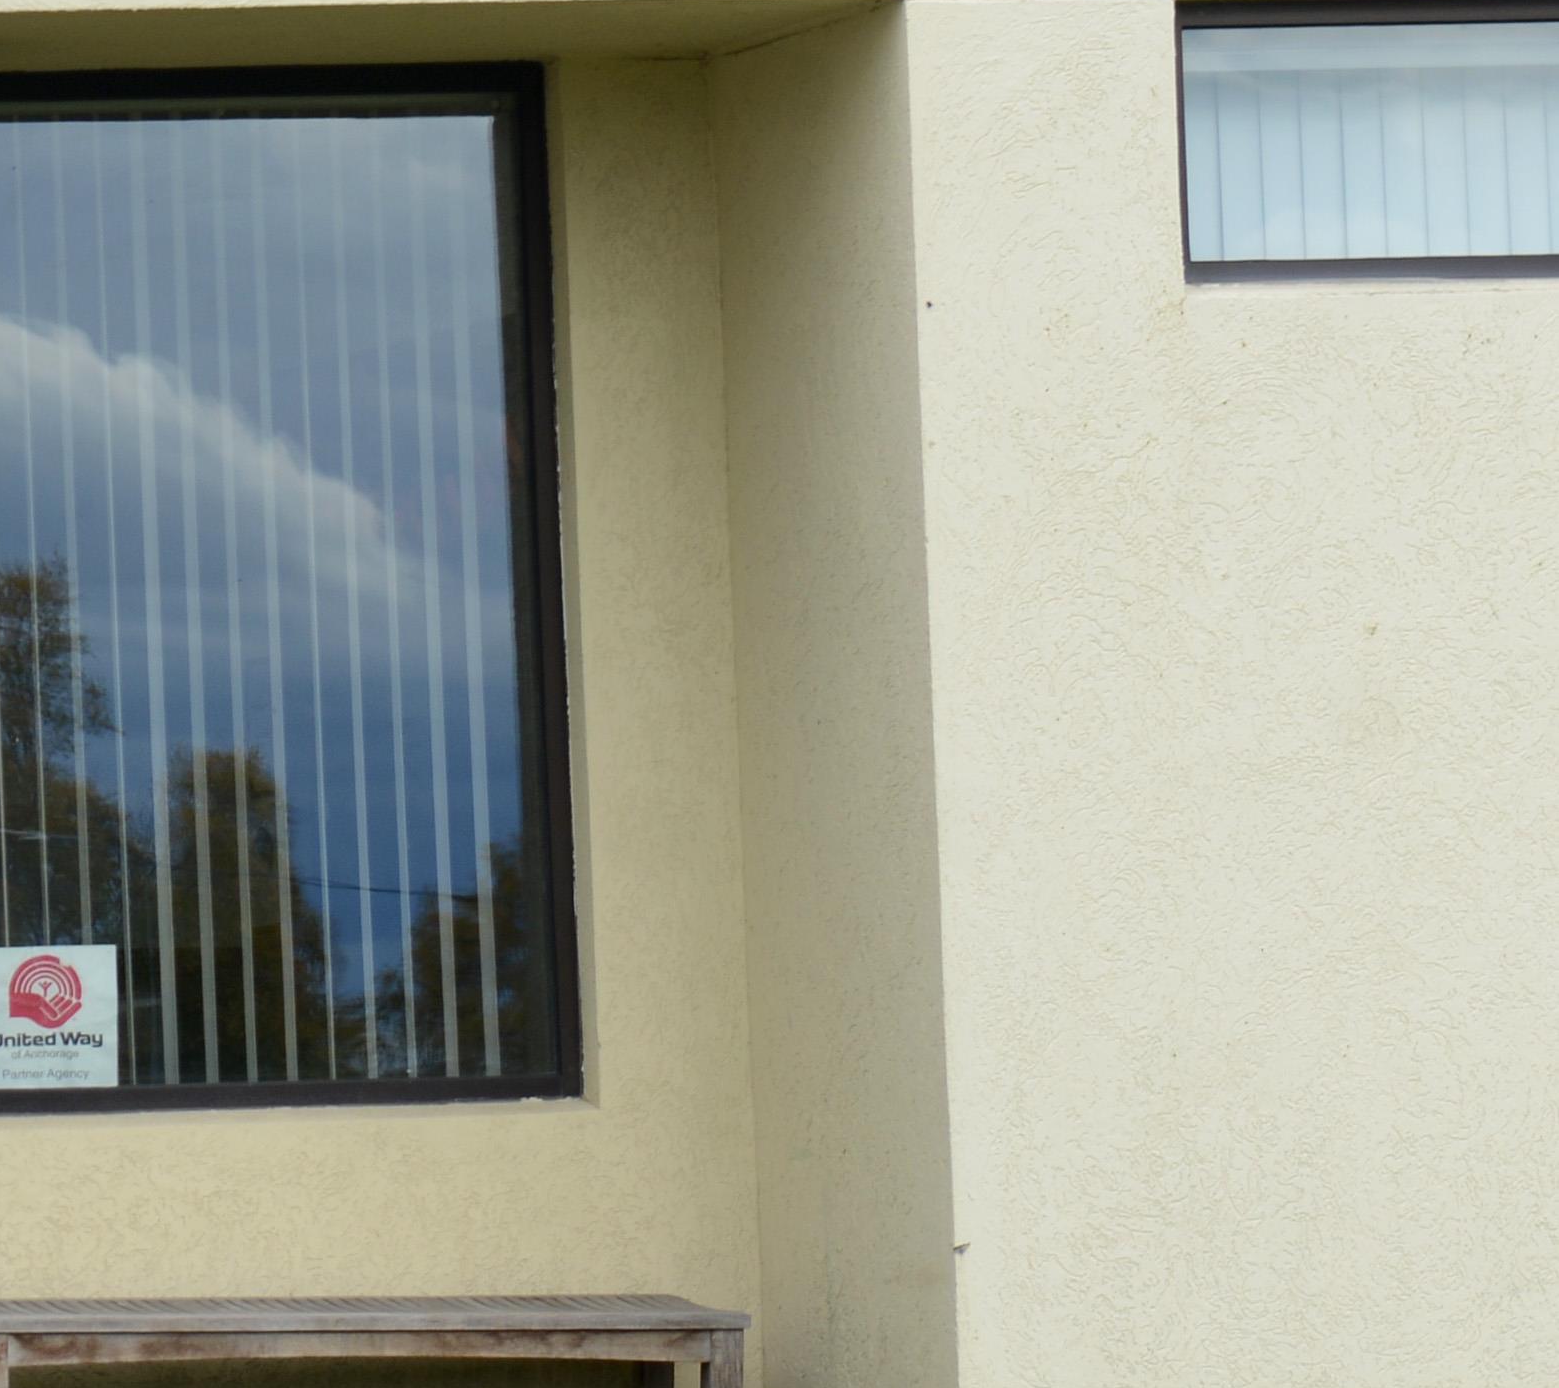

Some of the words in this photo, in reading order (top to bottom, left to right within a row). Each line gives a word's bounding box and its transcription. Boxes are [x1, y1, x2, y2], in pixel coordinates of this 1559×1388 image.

[59, 1031, 103, 1047] Way
[11, 1050, 21, 1060] of
[25, 1050, 79, 1062] Anchorage
[2, 1069, 44, 1080] Partner
[47, 1069, 90, 1082] Agency
